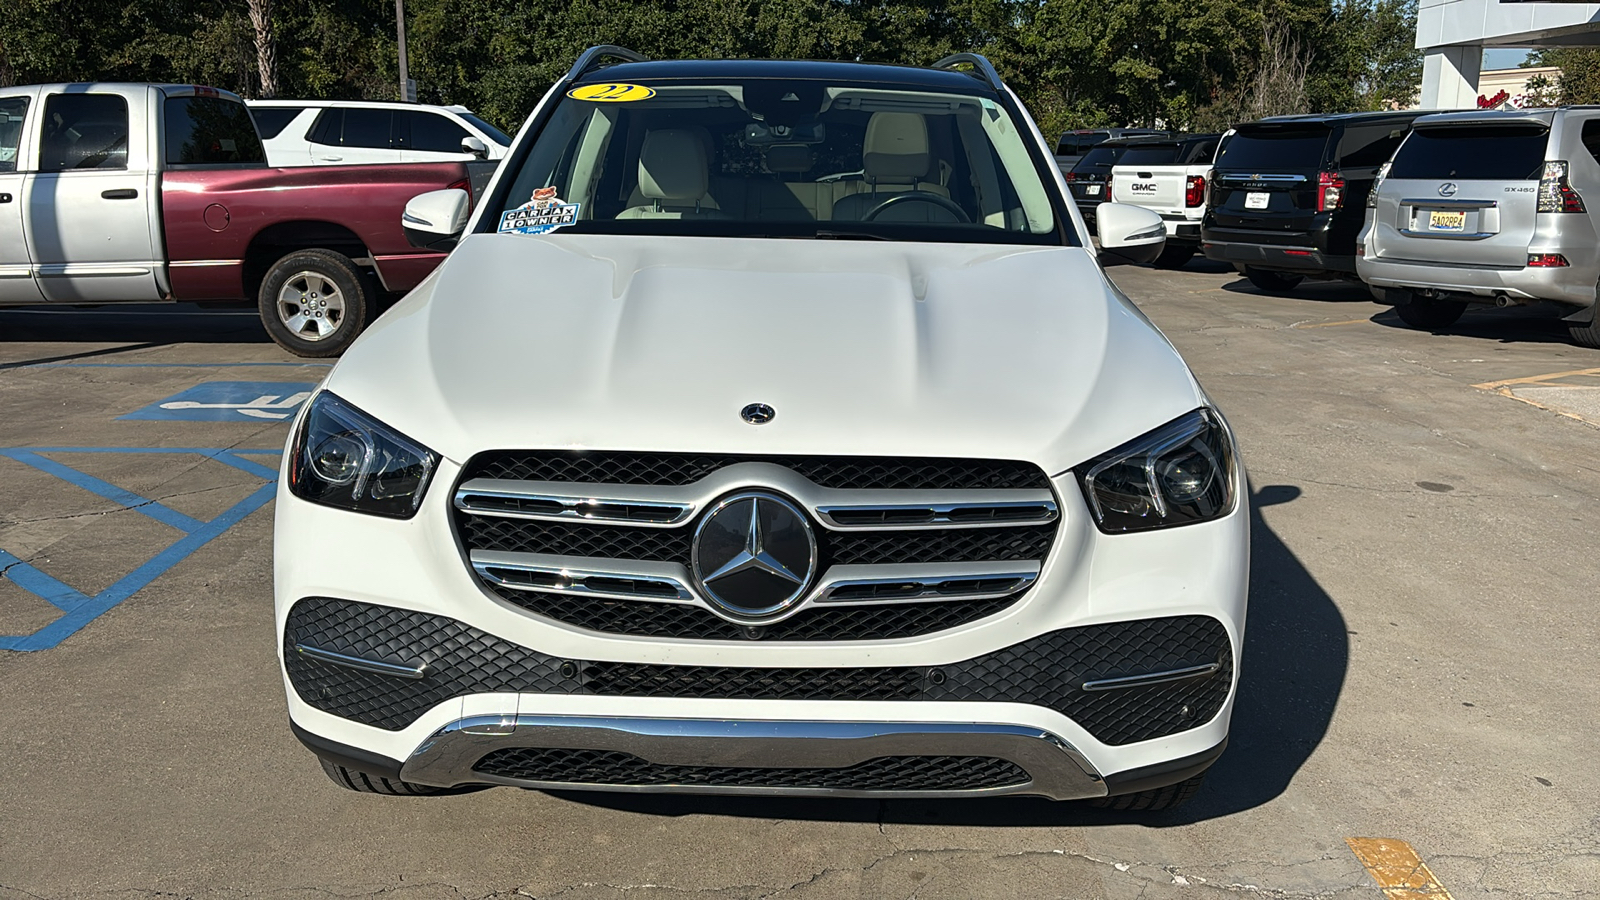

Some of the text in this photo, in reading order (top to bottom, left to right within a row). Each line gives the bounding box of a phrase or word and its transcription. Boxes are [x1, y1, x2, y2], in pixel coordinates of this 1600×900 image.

[587, 85, 635, 99] 22
[1131, 183, 1157, 191] GMC
[507, 208, 573, 220] CARFAX
[516, 215, 572, 227] OWNER
